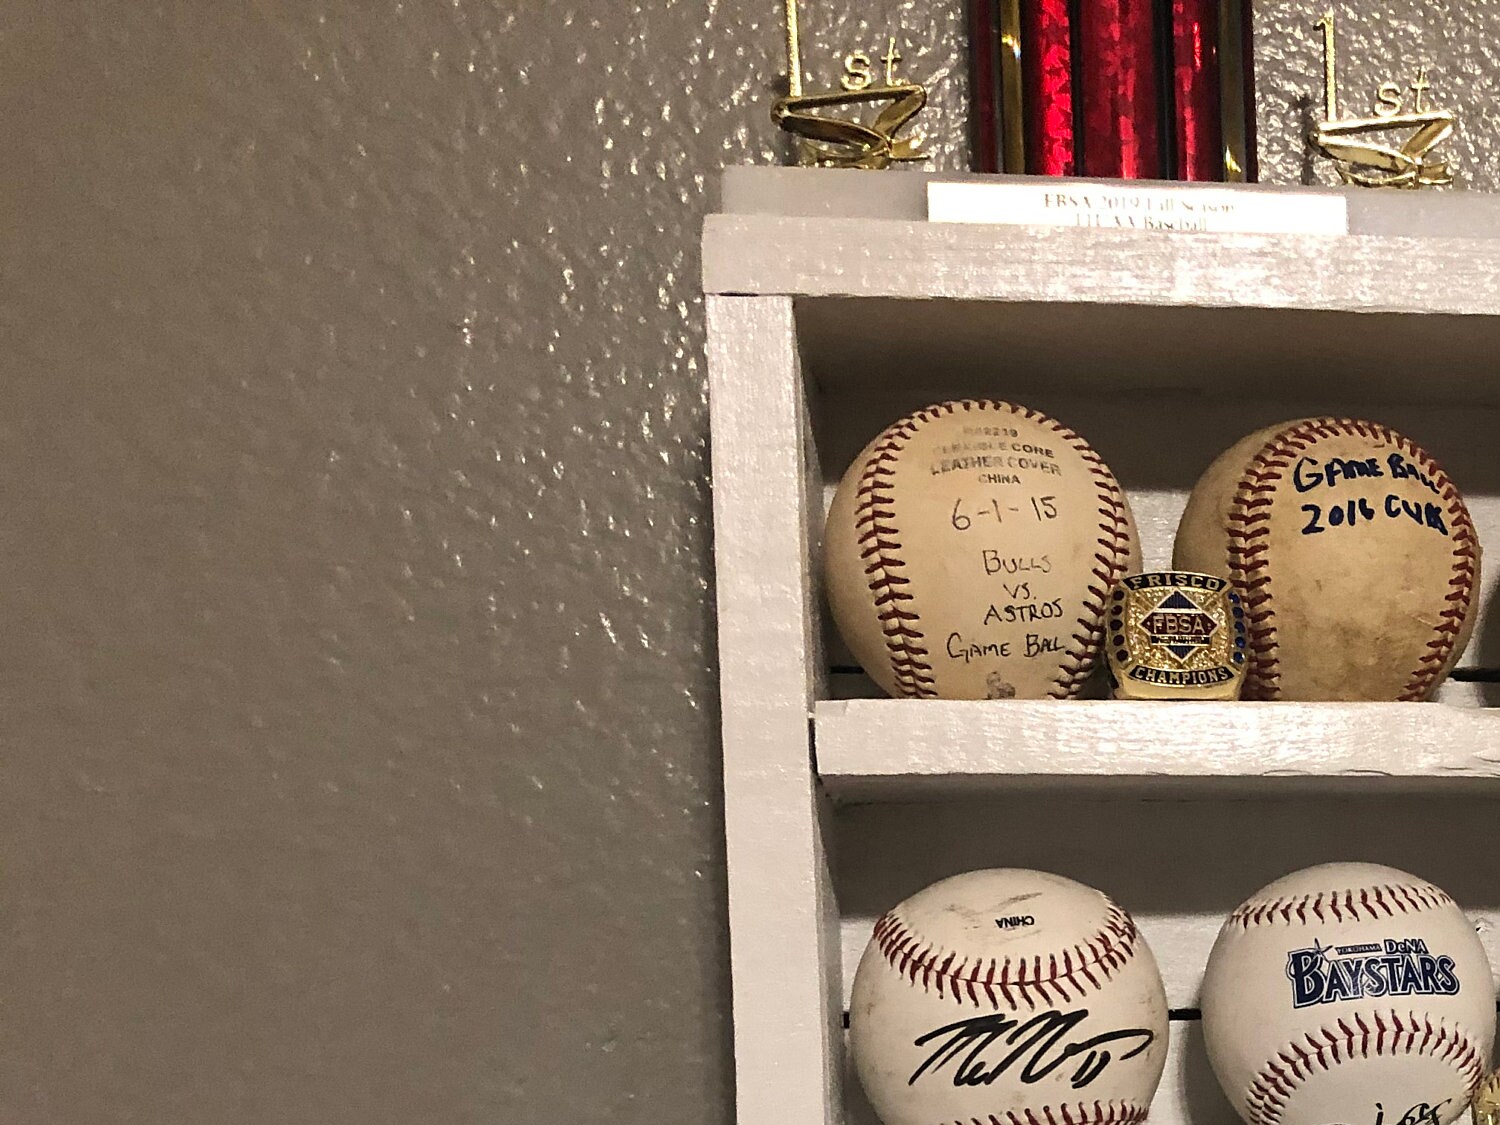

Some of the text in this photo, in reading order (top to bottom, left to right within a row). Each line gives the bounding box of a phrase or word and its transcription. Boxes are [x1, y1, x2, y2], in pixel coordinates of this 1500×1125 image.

[1011, 442, 1055, 459] CORE
[978, 473, 1021, 485] CHINA
[1293, 456, 1385, 494] GAME
[1300, 498, 1375, 536] 2016
[1131, 573, 1221, 591] FRISCO
[984, 598, 1064, 626] ASTROS
[1152, 614, 1206, 635] FBSA
[1133, 666, 1230, 687] CHAMPIONS
[994, 914, 1036, 930] CHINA
[1383, 938, 1430, 955] DeNA
[1285, 944, 1461, 1009] BAYSTARS
